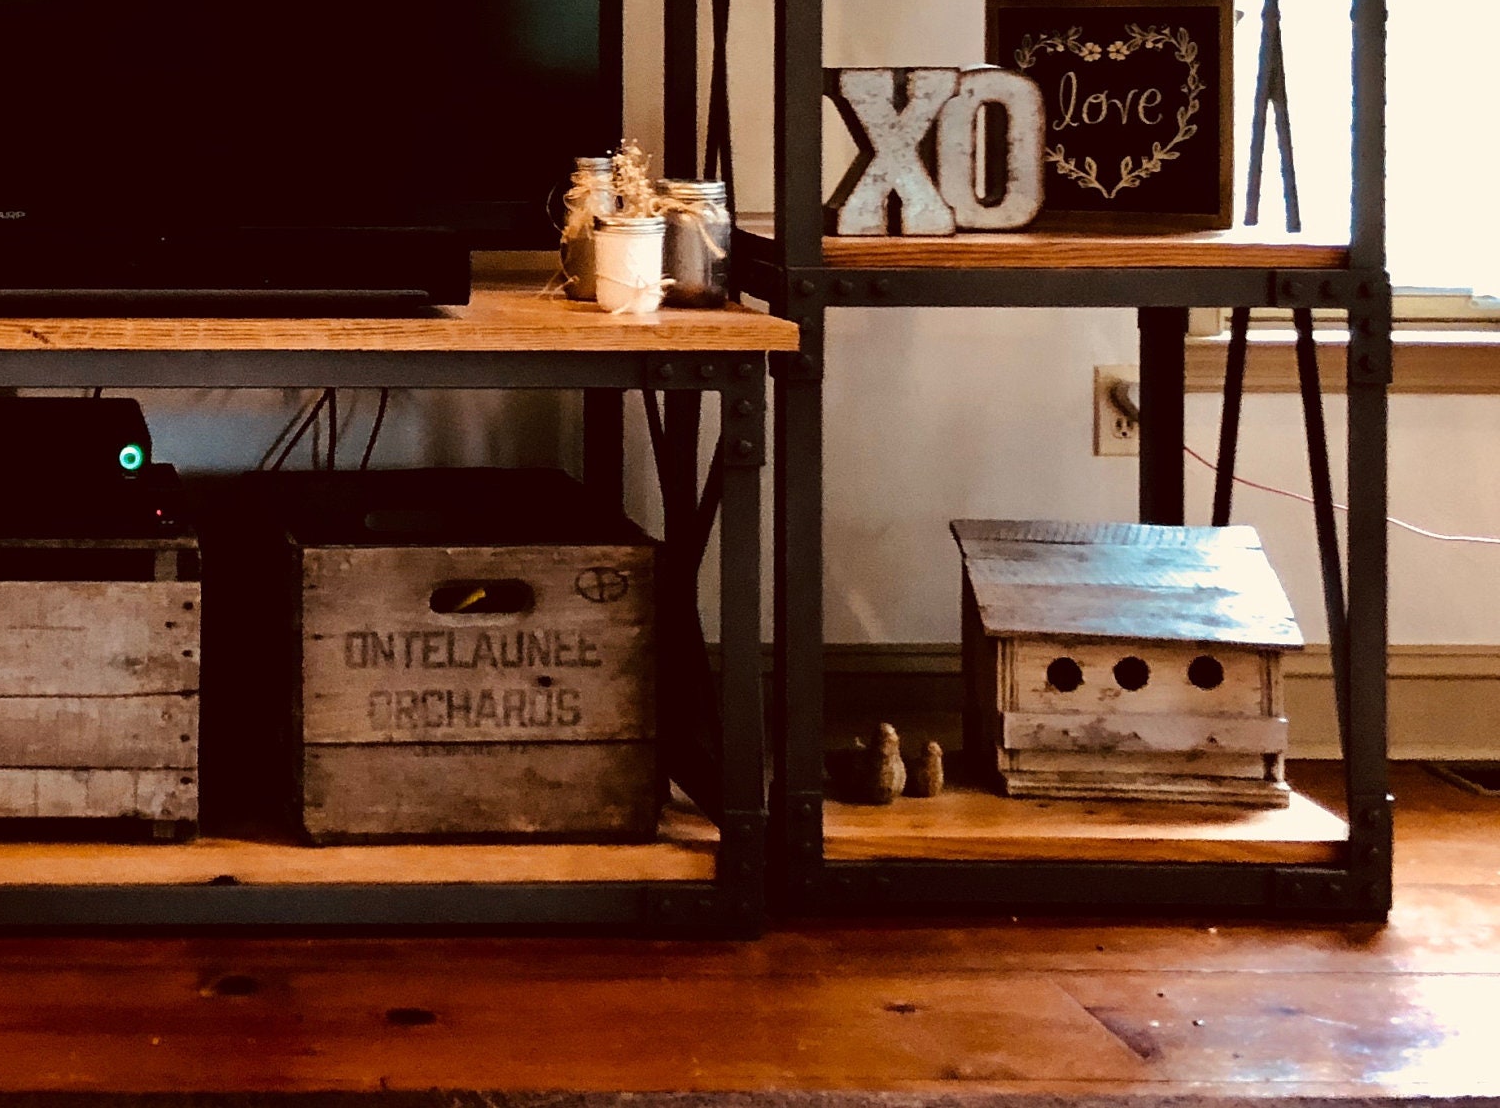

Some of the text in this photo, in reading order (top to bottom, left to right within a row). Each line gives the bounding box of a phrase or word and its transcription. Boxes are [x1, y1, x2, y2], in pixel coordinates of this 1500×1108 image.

[1053, 71, 1163, 131] love
[822, 66, 1047, 236] XO
[345, 629, 603, 670] ONTELAUNEE
